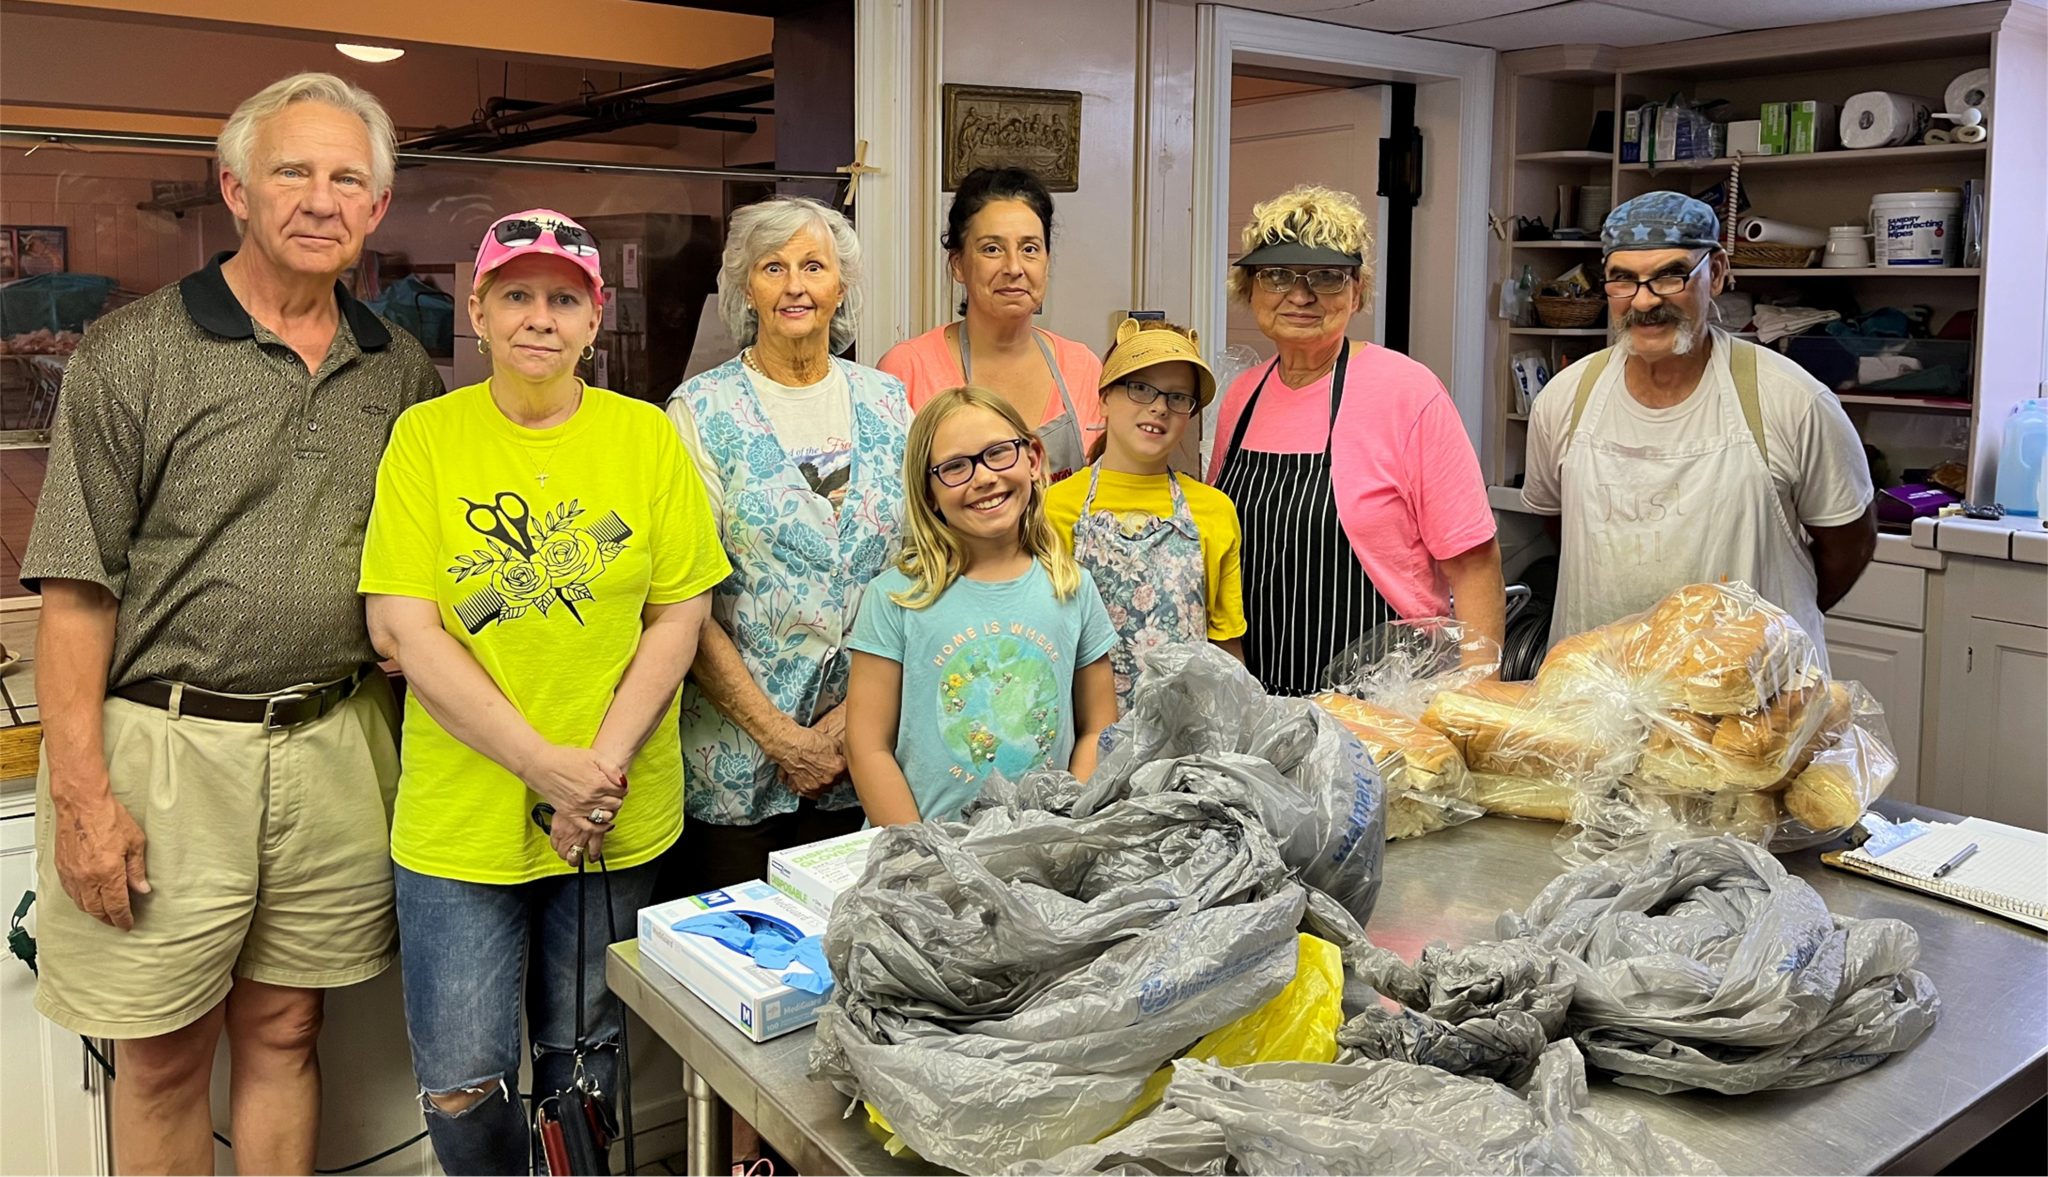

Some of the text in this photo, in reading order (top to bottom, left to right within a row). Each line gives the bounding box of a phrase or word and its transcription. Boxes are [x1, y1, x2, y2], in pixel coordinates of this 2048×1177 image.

[1888, 220, 1944, 230] Disinfecting
[1888, 230, 1913, 239] Wipes
[805, 446, 819, 456] the
[933, 621, 1061, 667] HOME IS WHERE
[948, 764, 976, 785] MY
[1332, 771, 1372, 863] Walmart
[800, 847, 857, 868] GLOVES
[771, 874, 808, 904] DISPOSABLE
[701, 891, 720, 906] M
[742, 1005, 751, 1025] M
[783, 998, 822, 1015] MediGuard
[766, 1022, 779, 1032] 100
